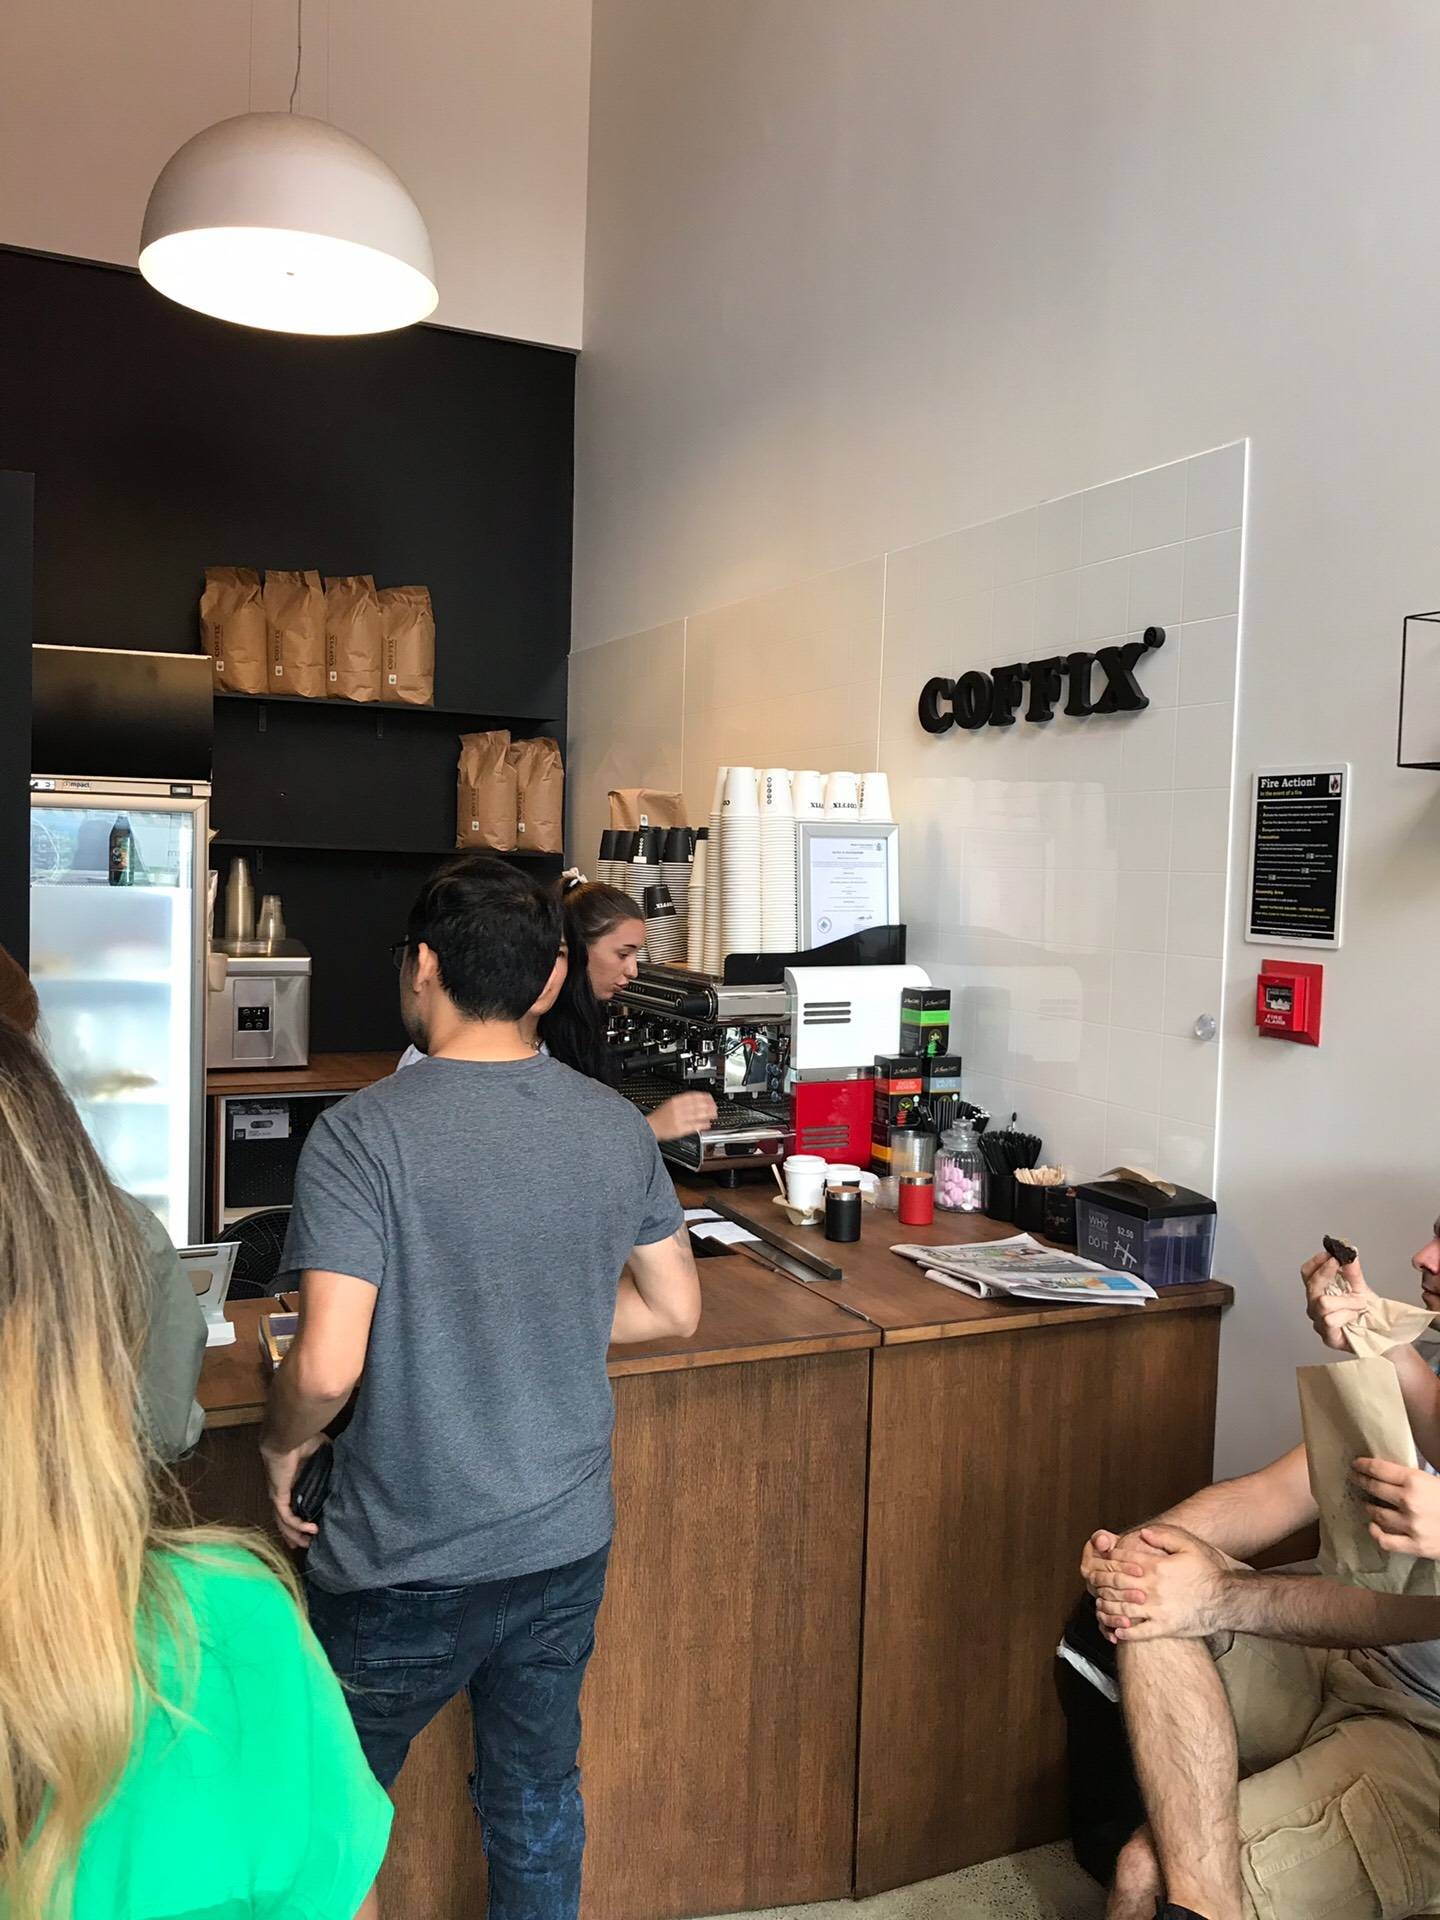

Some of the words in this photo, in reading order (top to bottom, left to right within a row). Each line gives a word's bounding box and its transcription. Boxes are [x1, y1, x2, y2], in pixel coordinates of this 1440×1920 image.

[918, 642, 1150, 733] COFFIX
[1260, 778, 1280, 788] Fire
[1281, 776, 1316, 787] Action!
[1088, 1215, 1109, 1229] WHY
[1088, 1235, 1100, 1248] DO
[1101, 1240, 1109, 1251] IT
